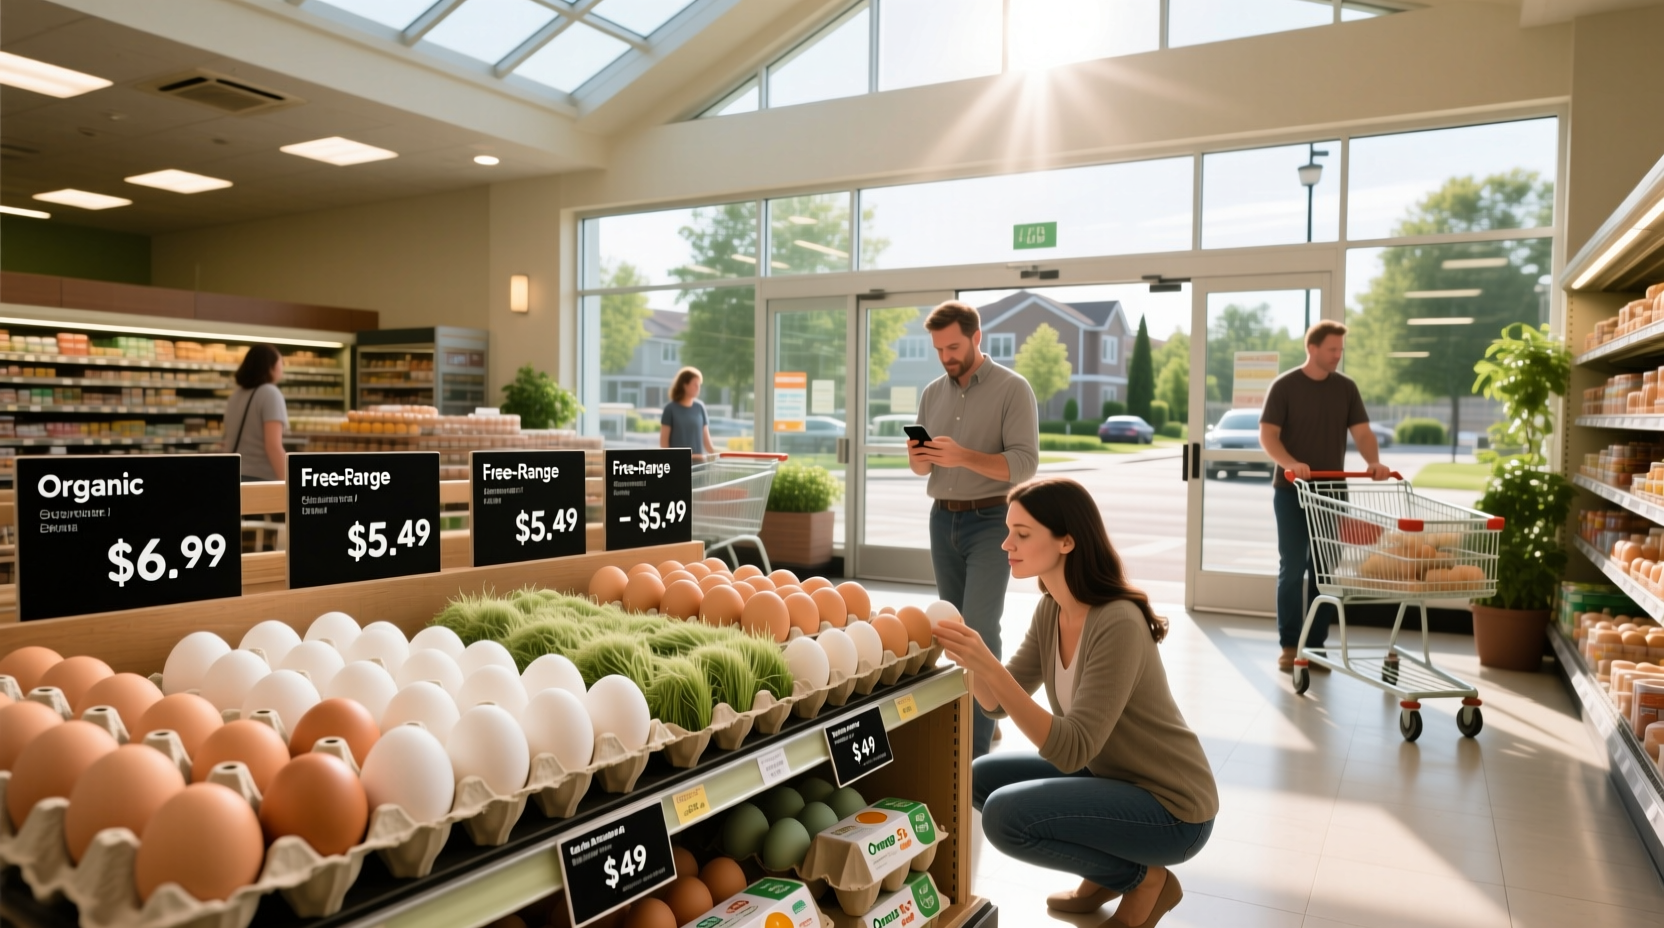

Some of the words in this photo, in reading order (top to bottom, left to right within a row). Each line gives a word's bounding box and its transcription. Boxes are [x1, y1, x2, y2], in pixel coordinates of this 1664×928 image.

[38, 472, 143, 503] Organic
[516, 508, 577, 545] $5.49
[639, 500, 686, 532] $5.49
[348, 519, 430, 562] $5.49
[108, 534, 226, 587] $6.99
[852, 735, 875, 764] $49
[604, 845, 647, 889] $49
